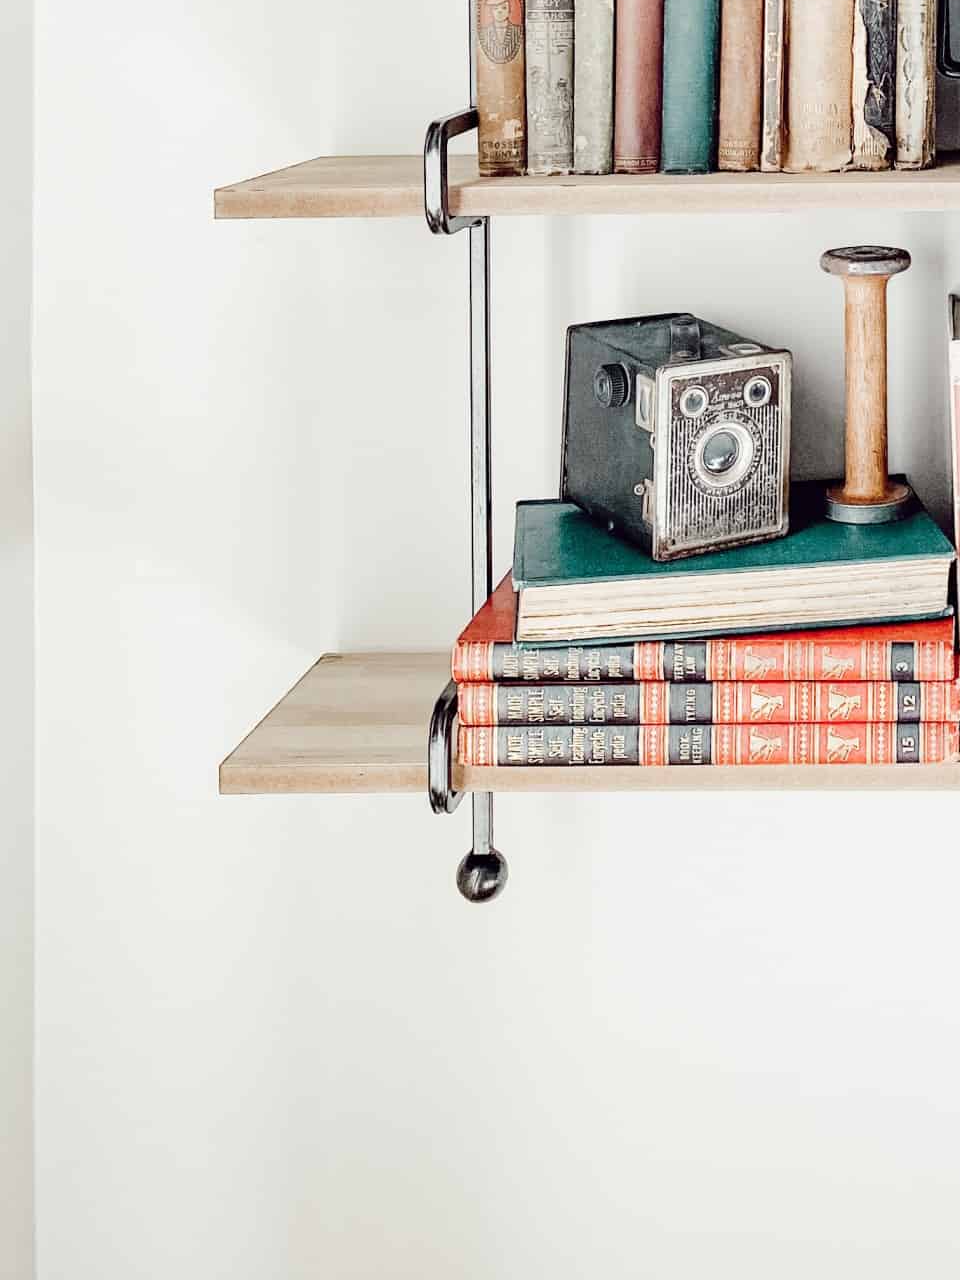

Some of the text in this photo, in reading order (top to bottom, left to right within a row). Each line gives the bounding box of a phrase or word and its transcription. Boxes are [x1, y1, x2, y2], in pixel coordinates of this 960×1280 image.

[674, 643, 684, 680] VERYDAY
[686, 656, 696, 674] LAW
[895, 661, 908, 672] 3
[507, 694, 523, 719] MADE
[528, 689, 544, 722] SIMPLE
[686, 688, 696, 721] TYPING
[903, 695, 916, 712] 12
[507, 734, 523, 761] MADE
[528, 729, 544, 764] SIMPLE
[679, 733, 690, 760] BOOK-
[902, 736, 915, 753] 15
